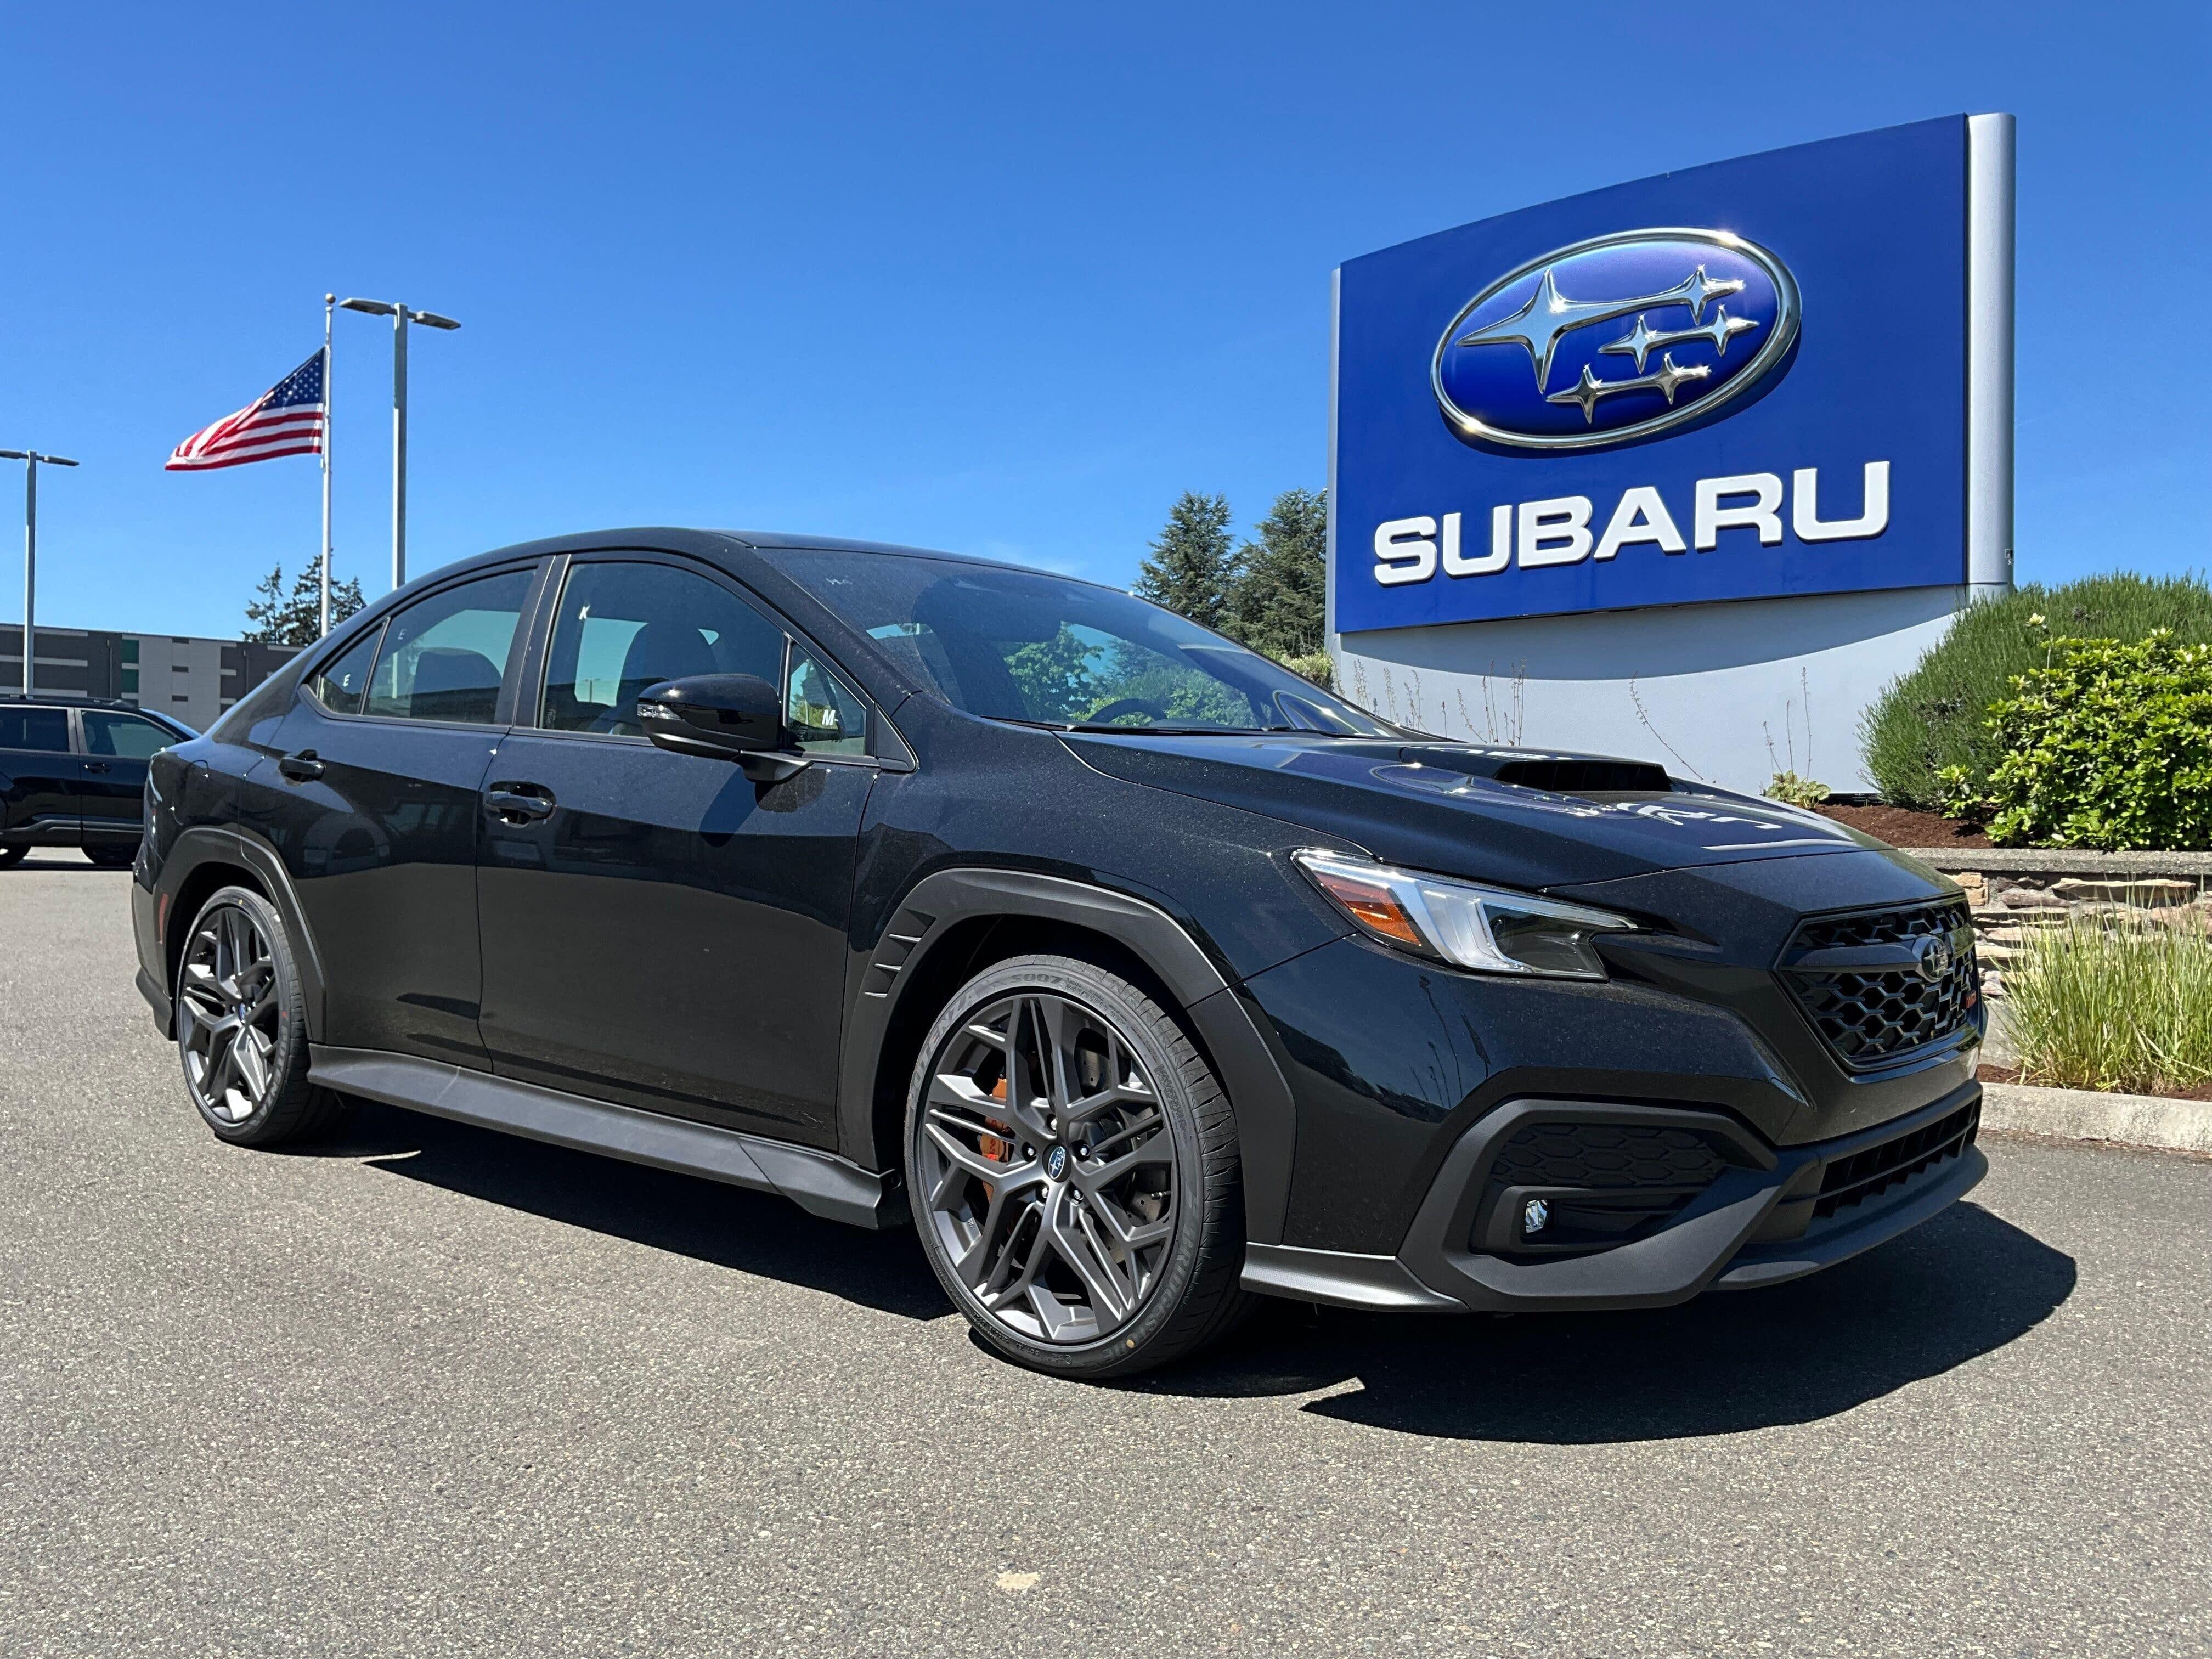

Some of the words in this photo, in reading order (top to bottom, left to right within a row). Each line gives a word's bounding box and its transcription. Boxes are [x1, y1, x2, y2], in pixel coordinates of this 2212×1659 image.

[1374, 461, 1890, 585] SUBARU
[343, 674, 351, 687] E
[822, 709, 836, 725] M
